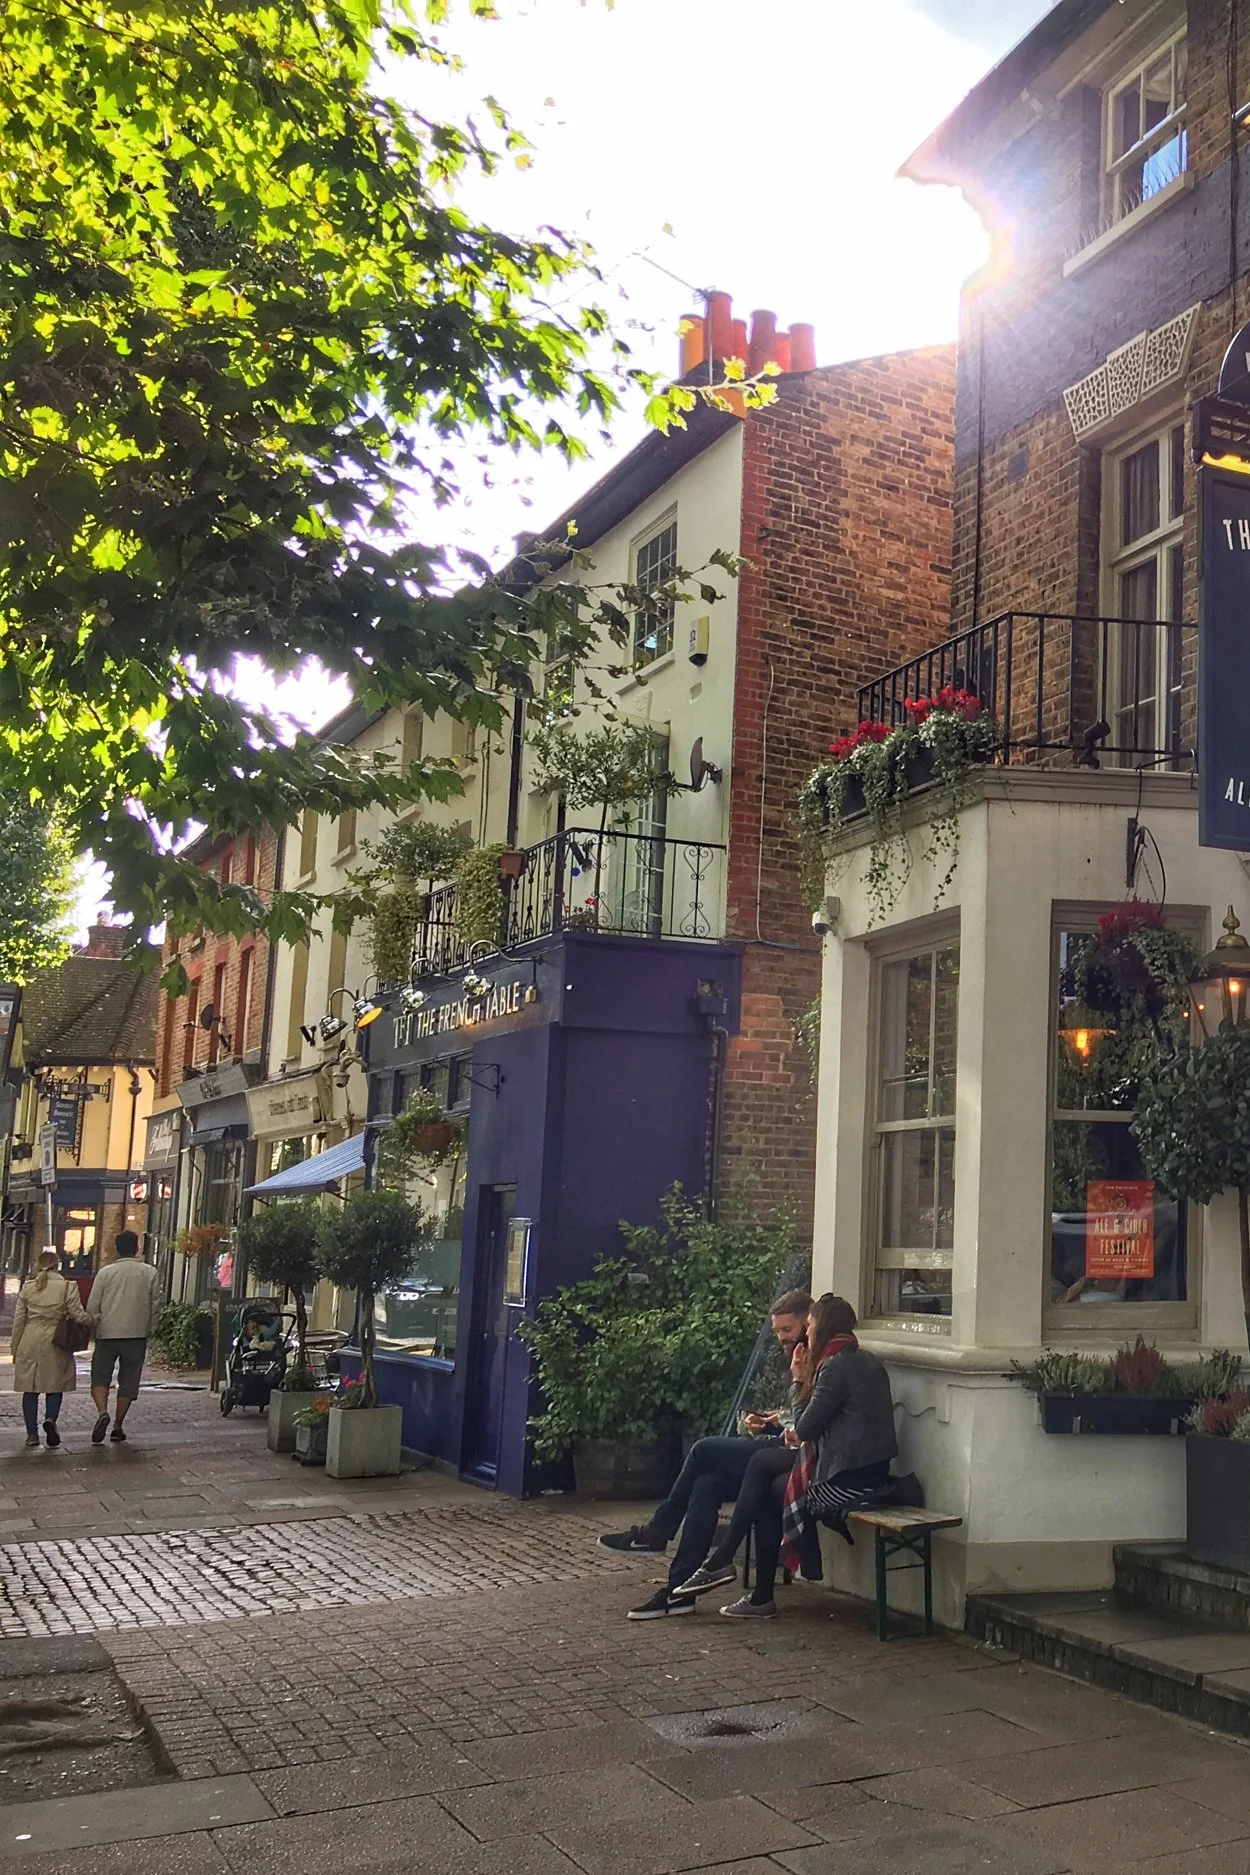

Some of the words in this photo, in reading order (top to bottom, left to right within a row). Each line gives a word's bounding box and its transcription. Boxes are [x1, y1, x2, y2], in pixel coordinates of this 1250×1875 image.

[416, 1009, 436, 1038] THE
[1094, 1219, 1109, 1234] ALE
[1124, 1219, 1148, 1234] CIDER
[1100, 1239, 1141, 1255] FESTIVAL
